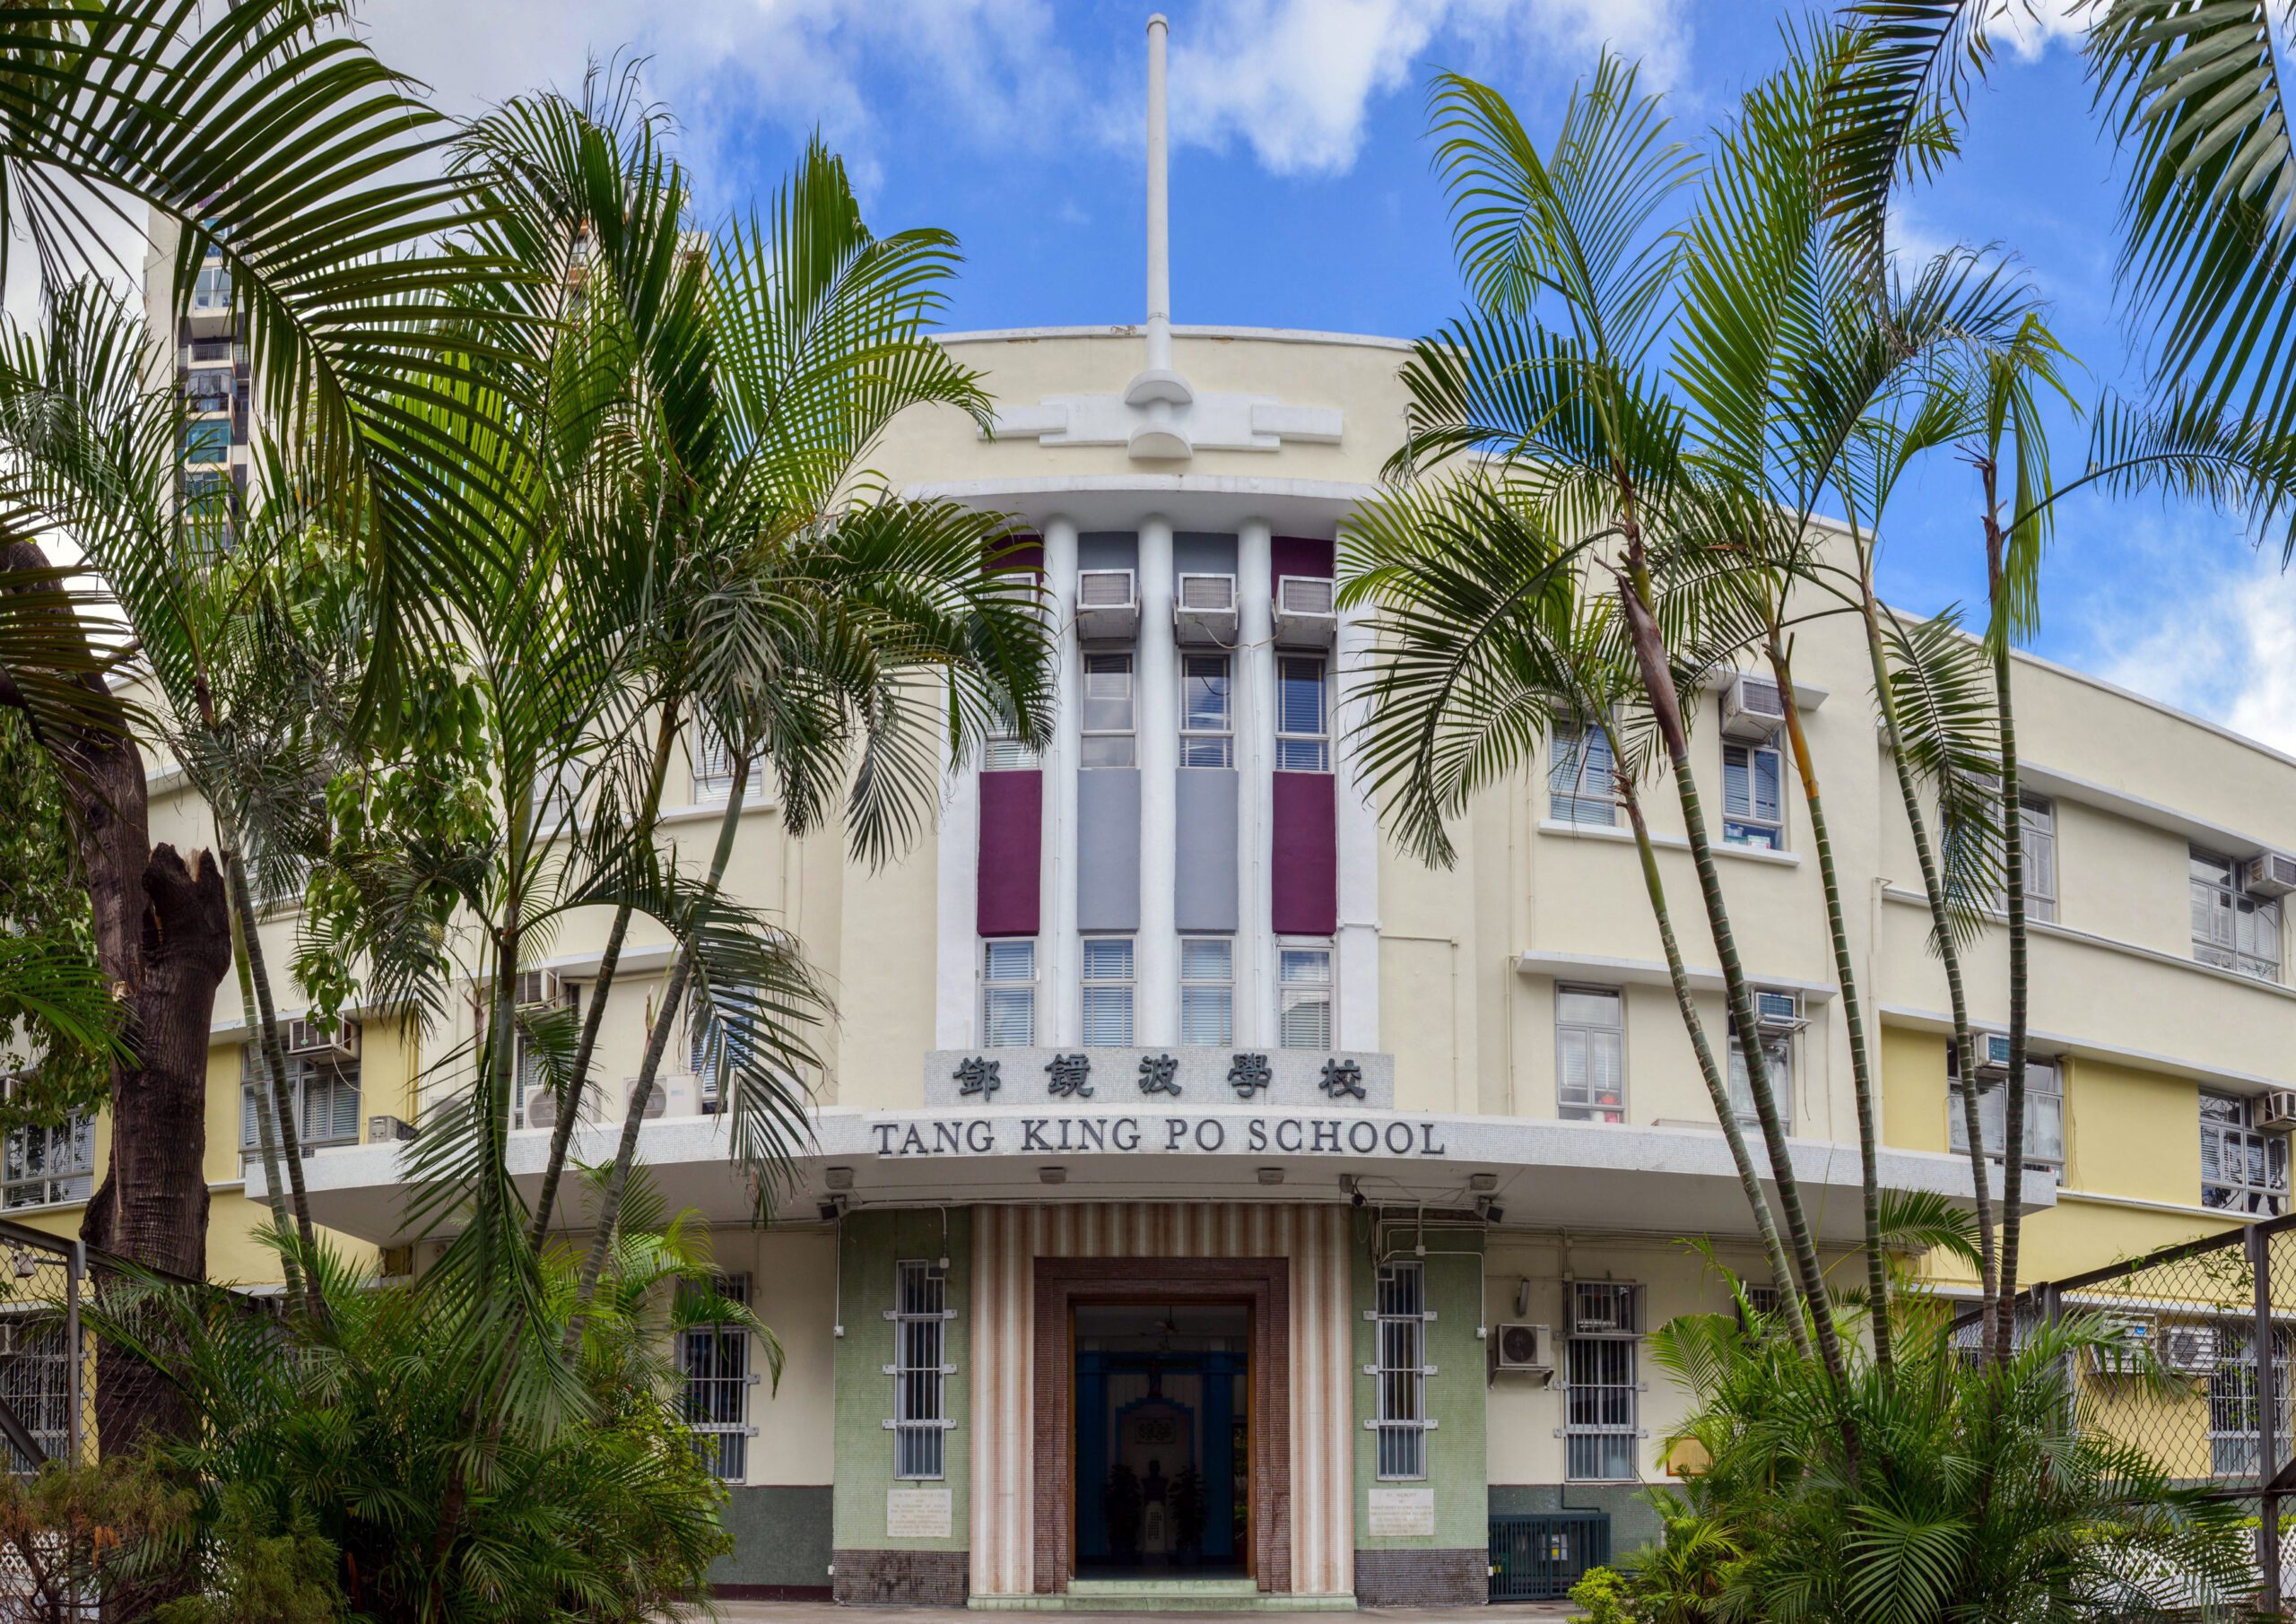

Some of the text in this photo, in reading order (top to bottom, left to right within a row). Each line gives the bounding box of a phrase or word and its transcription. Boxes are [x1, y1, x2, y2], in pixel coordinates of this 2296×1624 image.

[952, 1053, 1367, 1102] 鄧鏡波學校
[873, 1117, 1446, 1155] TANG KING PO SCHOOL
